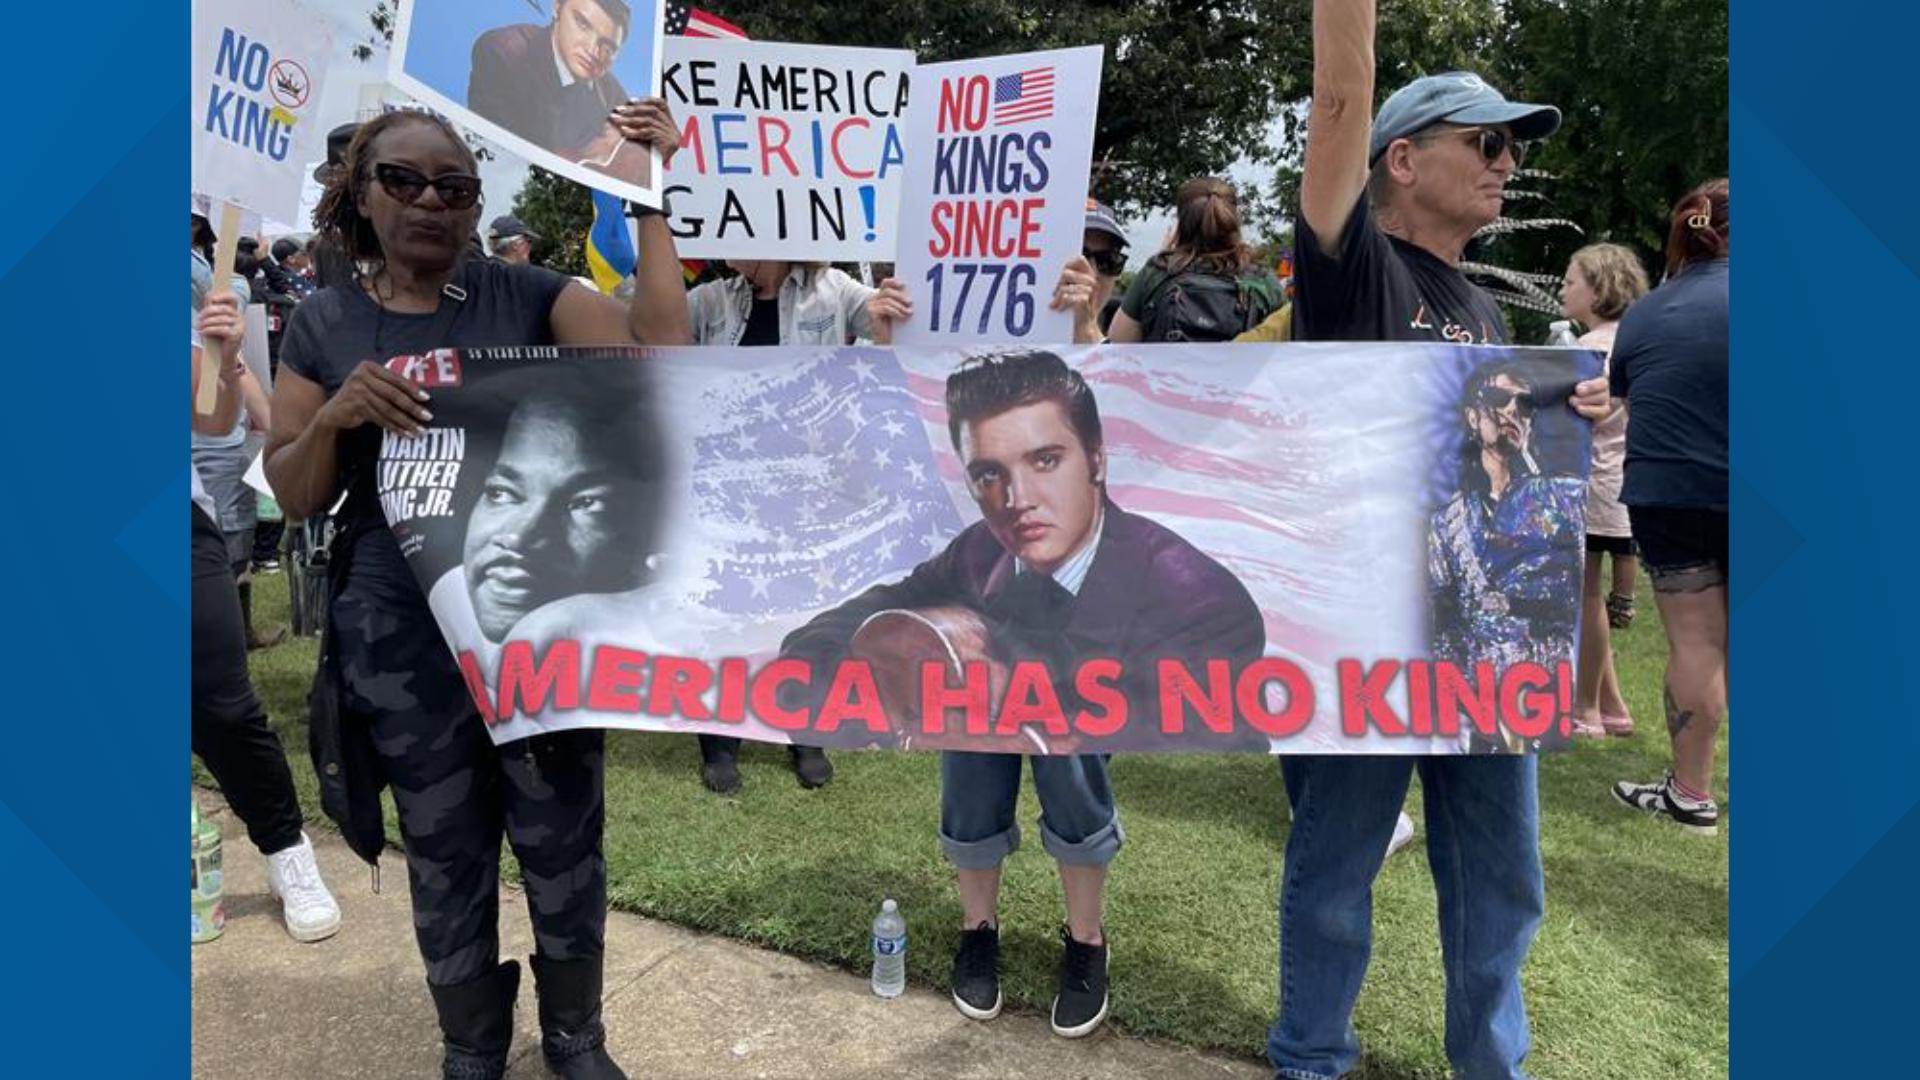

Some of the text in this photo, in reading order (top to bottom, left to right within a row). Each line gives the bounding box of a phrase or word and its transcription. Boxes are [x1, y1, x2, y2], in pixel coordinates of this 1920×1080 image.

[215, 26, 269, 92] NO
[662, 61, 910, 118] KE AMERICA
[205, 83, 293, 161] KING
[937, 74, 990, 134] NO
[663, 113, 904, 180] MERICA
[933, 131, 1052, 195] KINGS
[662, 184, 877, 243] GAIN!
[928, 198, 1045, 259] SINCE
[926, 263, 1037, 337] 1776
[416, 488, 454, 518] JR.
[922, 659, 1128, 736] HAS
[1156, 659, 1315, 737] NO
[1337, 658, 1572, 738] KING!
